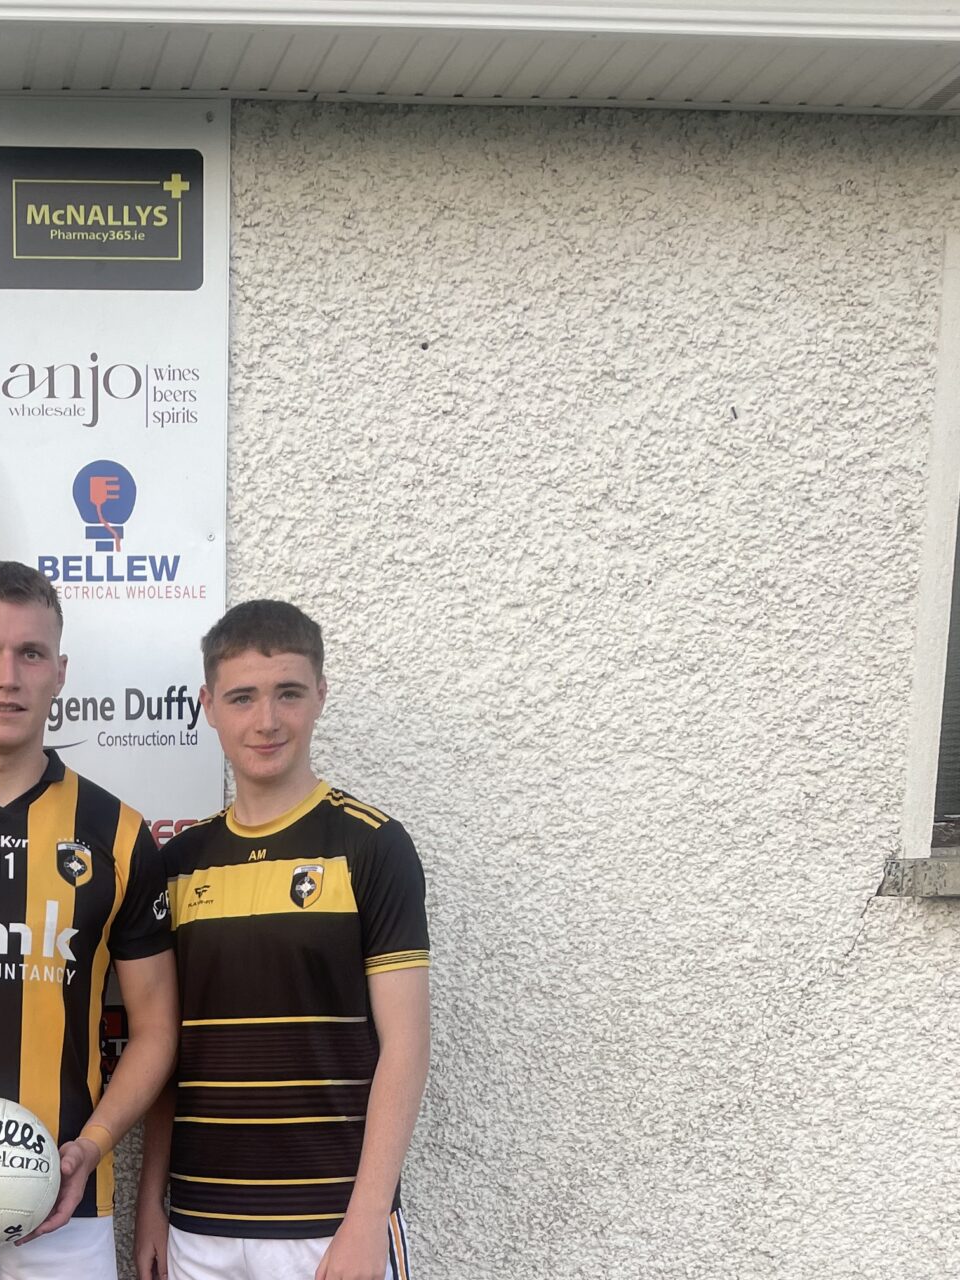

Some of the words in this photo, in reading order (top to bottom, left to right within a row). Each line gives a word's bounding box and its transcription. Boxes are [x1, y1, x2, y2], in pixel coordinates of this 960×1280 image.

[27, 204, 168, 226] McNALLYS
[50, 229, 145, 242] Pharmacy365.ie
[153, 364, 199, 382] wines
[1, 352, 142, 428] anjo
[153, 386, 197, 402] beers
[8, 404, 85, 417] wholesale
[152, 407, 198, 428] spirits
[38, 555, 180, 582] BELLEW
[55, 586, 120, 599] ECTRICAL
[126, 585, 206, 599] WHOLESALE
[48, 695, 115, 731] gene
[126, 685, 202, 730] Duffy
[97, 731, 175, 747] Construction
[180, 731, 198, 746] Ltd
[248, 849, 267, 861] AM
